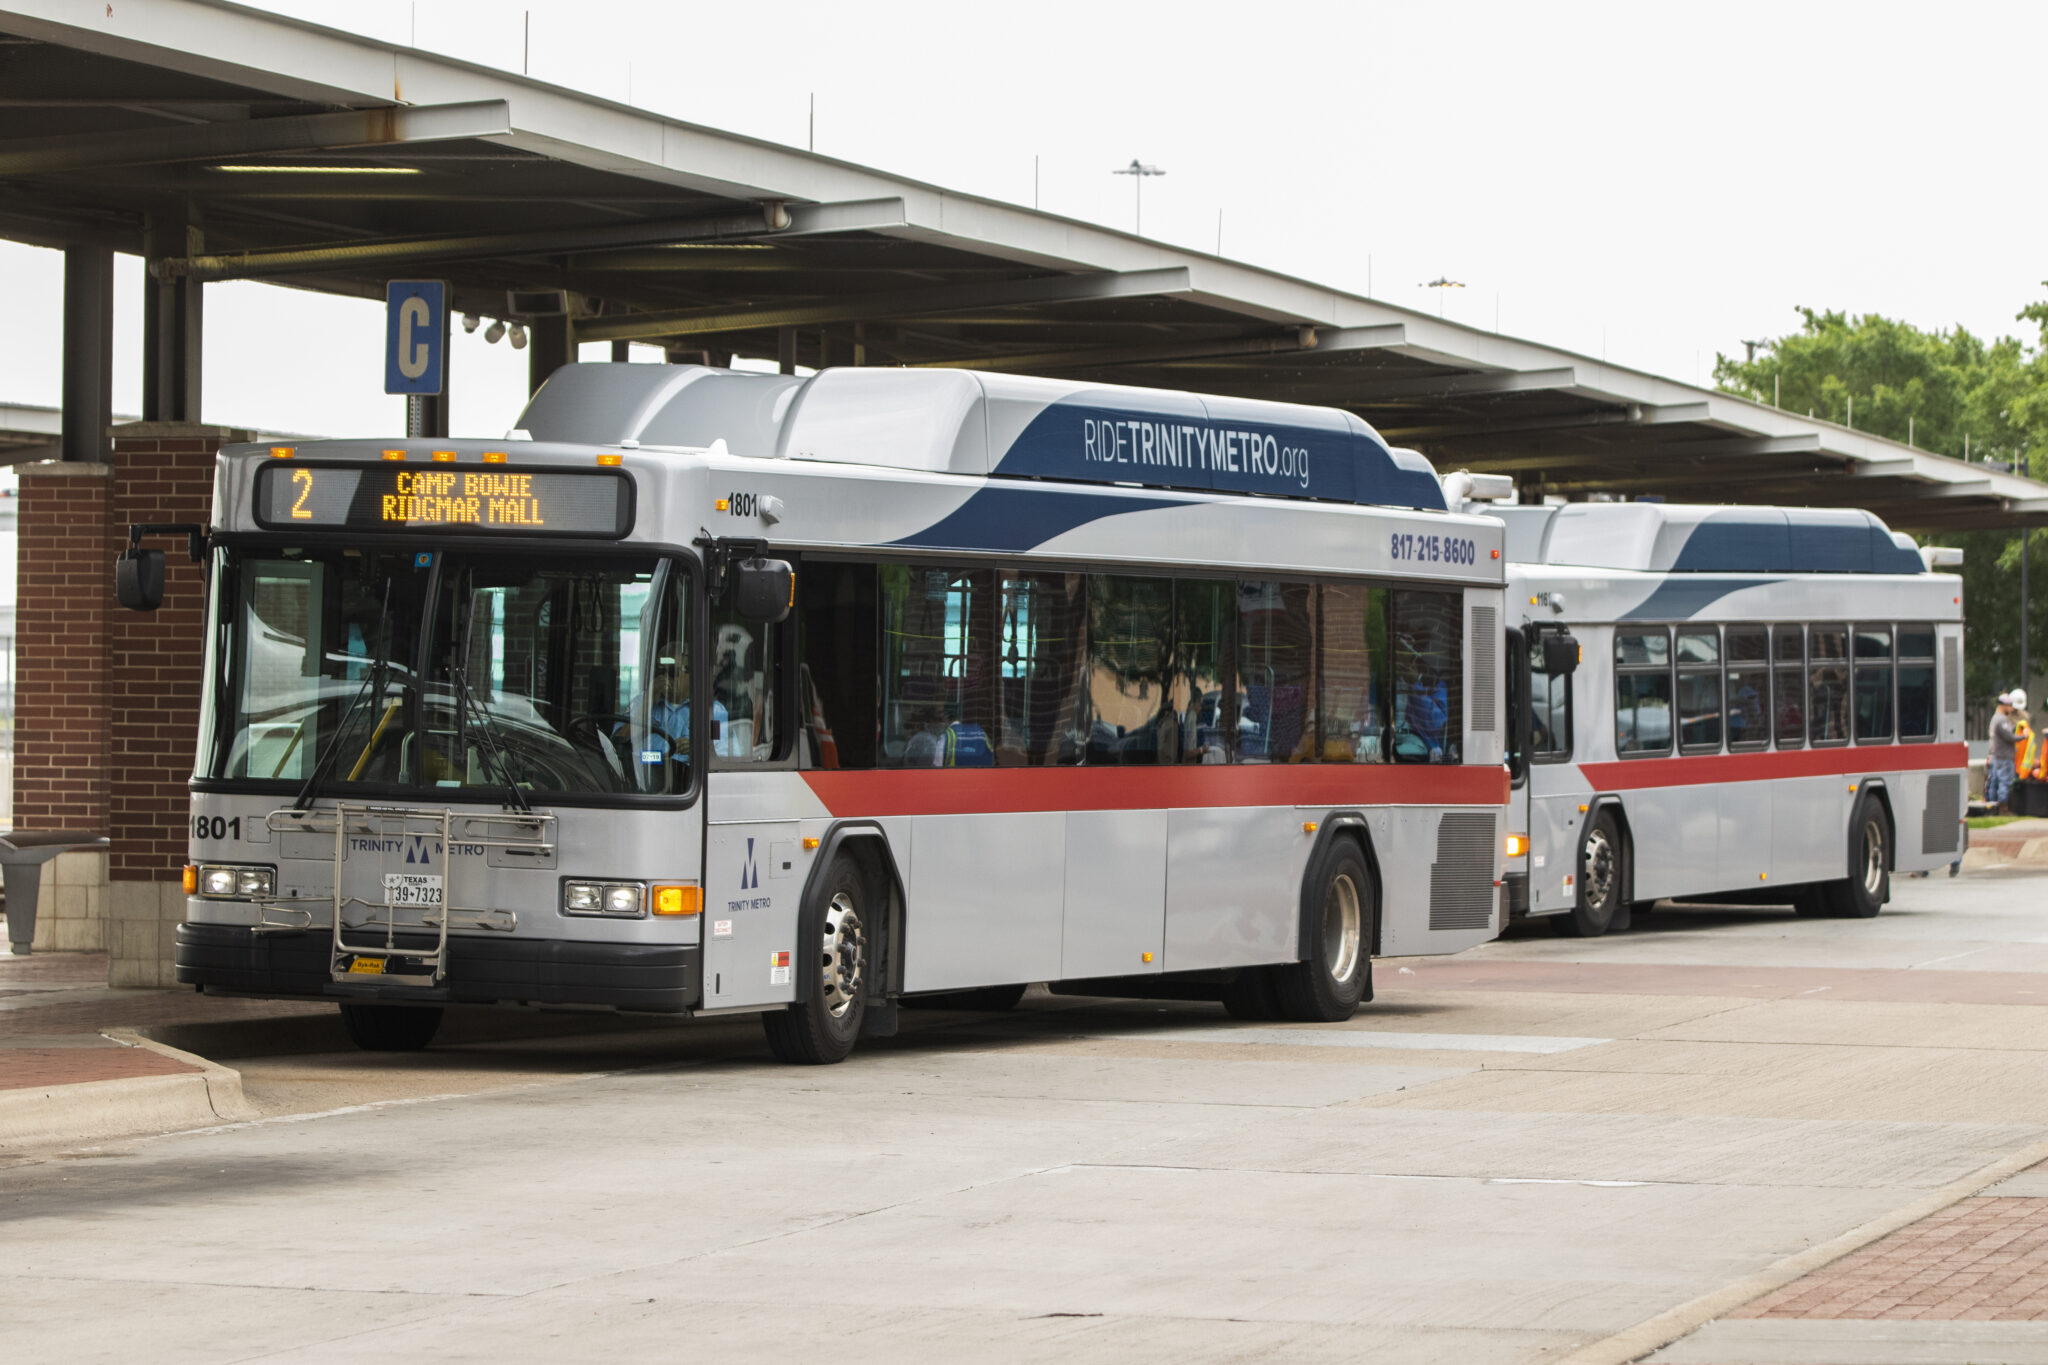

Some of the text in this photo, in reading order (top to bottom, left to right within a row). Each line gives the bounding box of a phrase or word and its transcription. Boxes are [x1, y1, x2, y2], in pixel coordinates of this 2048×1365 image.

[398, 296, 430, 379] C
[1084, 418, 1309, 488] RIDETRINITYMETRO.org
[291, 469, 312, 519] 2
[397, 472, 532, 497] CAMP BOWIE
[382, 496, 544, 525] RIDGMAR MALL
[727, 492, 757, 517] 1801
[1391, 533, 1475, 566] 817-215-8600
[190, 815, 240, 840] 1801
[351, 839, 485, 856] TRINITY METRO
[404, 876, 427, 884] TEXAS
[728, 897, 771, 912] TRINITY METRO
